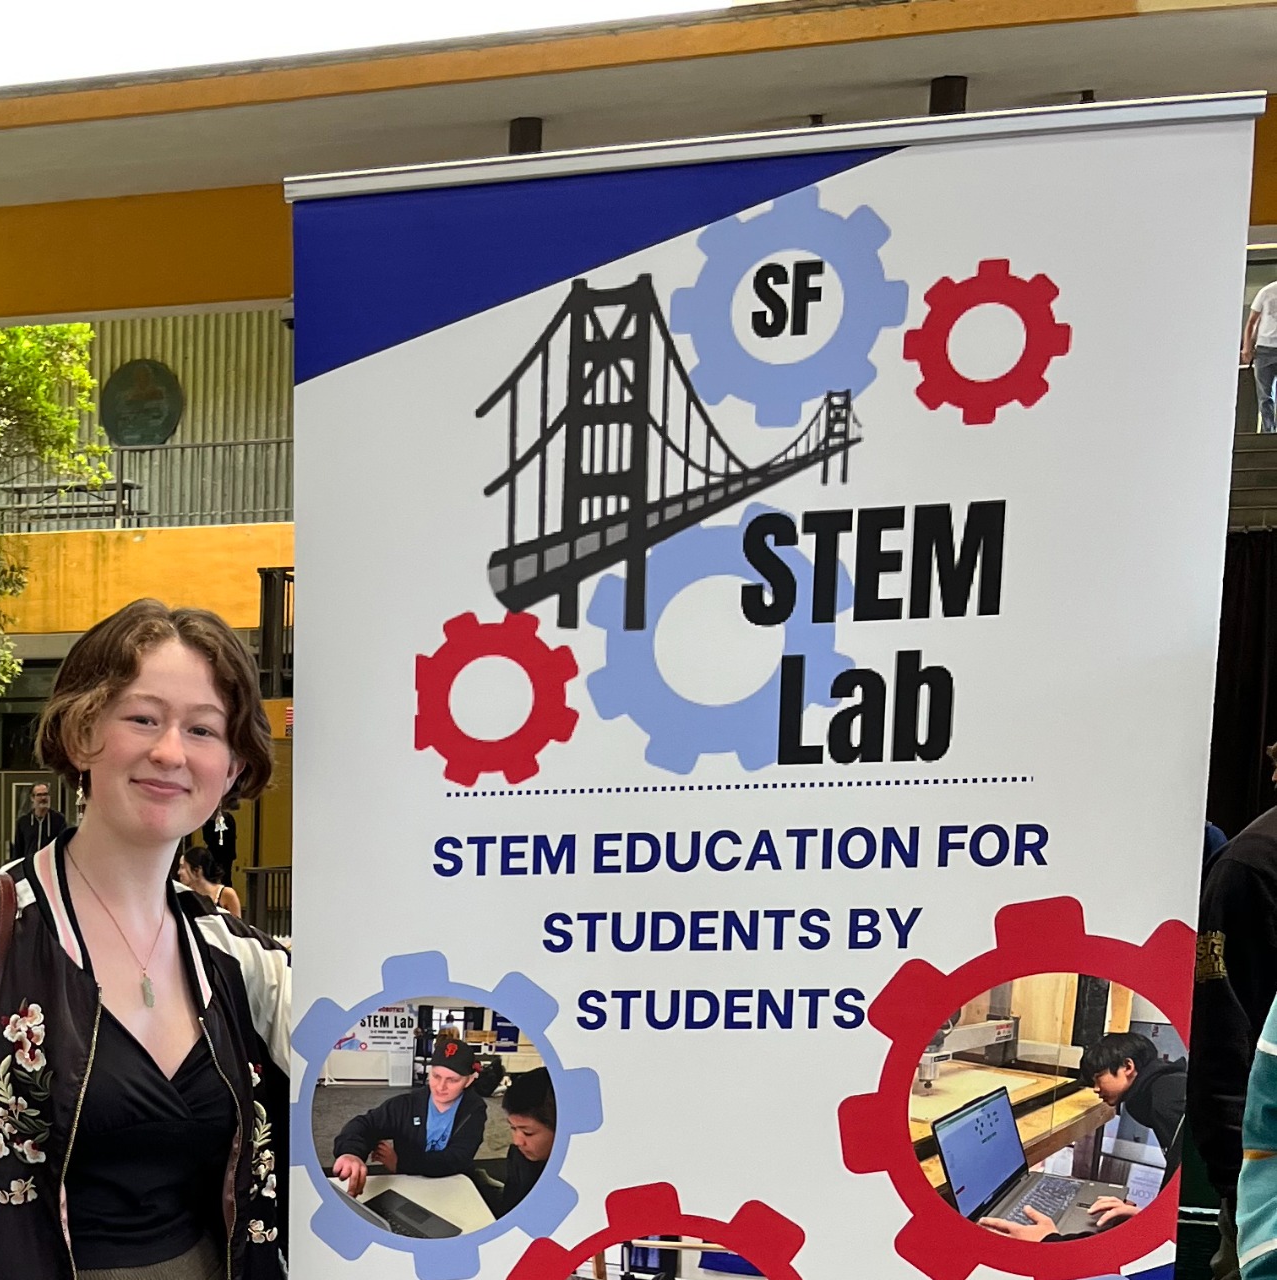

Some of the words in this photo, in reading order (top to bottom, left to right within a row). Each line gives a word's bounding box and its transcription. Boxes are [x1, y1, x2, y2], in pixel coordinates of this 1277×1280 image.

[751, 261, 825, 338] SF
[741, 500, 1006, 626] STEM
[778, 650, 954, 765] Lab
[432, 833, 577, 877] STEM
[593, 826, 920, 873] EDUCATION
[936, 823, 1050, 867] FOR
[543, 908, 831, 953] STUDENTS
[848, 907, 922, 949] BY
[360, 1015, 389, 1028] STEM
[394, 1016, 414, 1028] Lab
[576, 987, 866, 1030] STUDENTS
